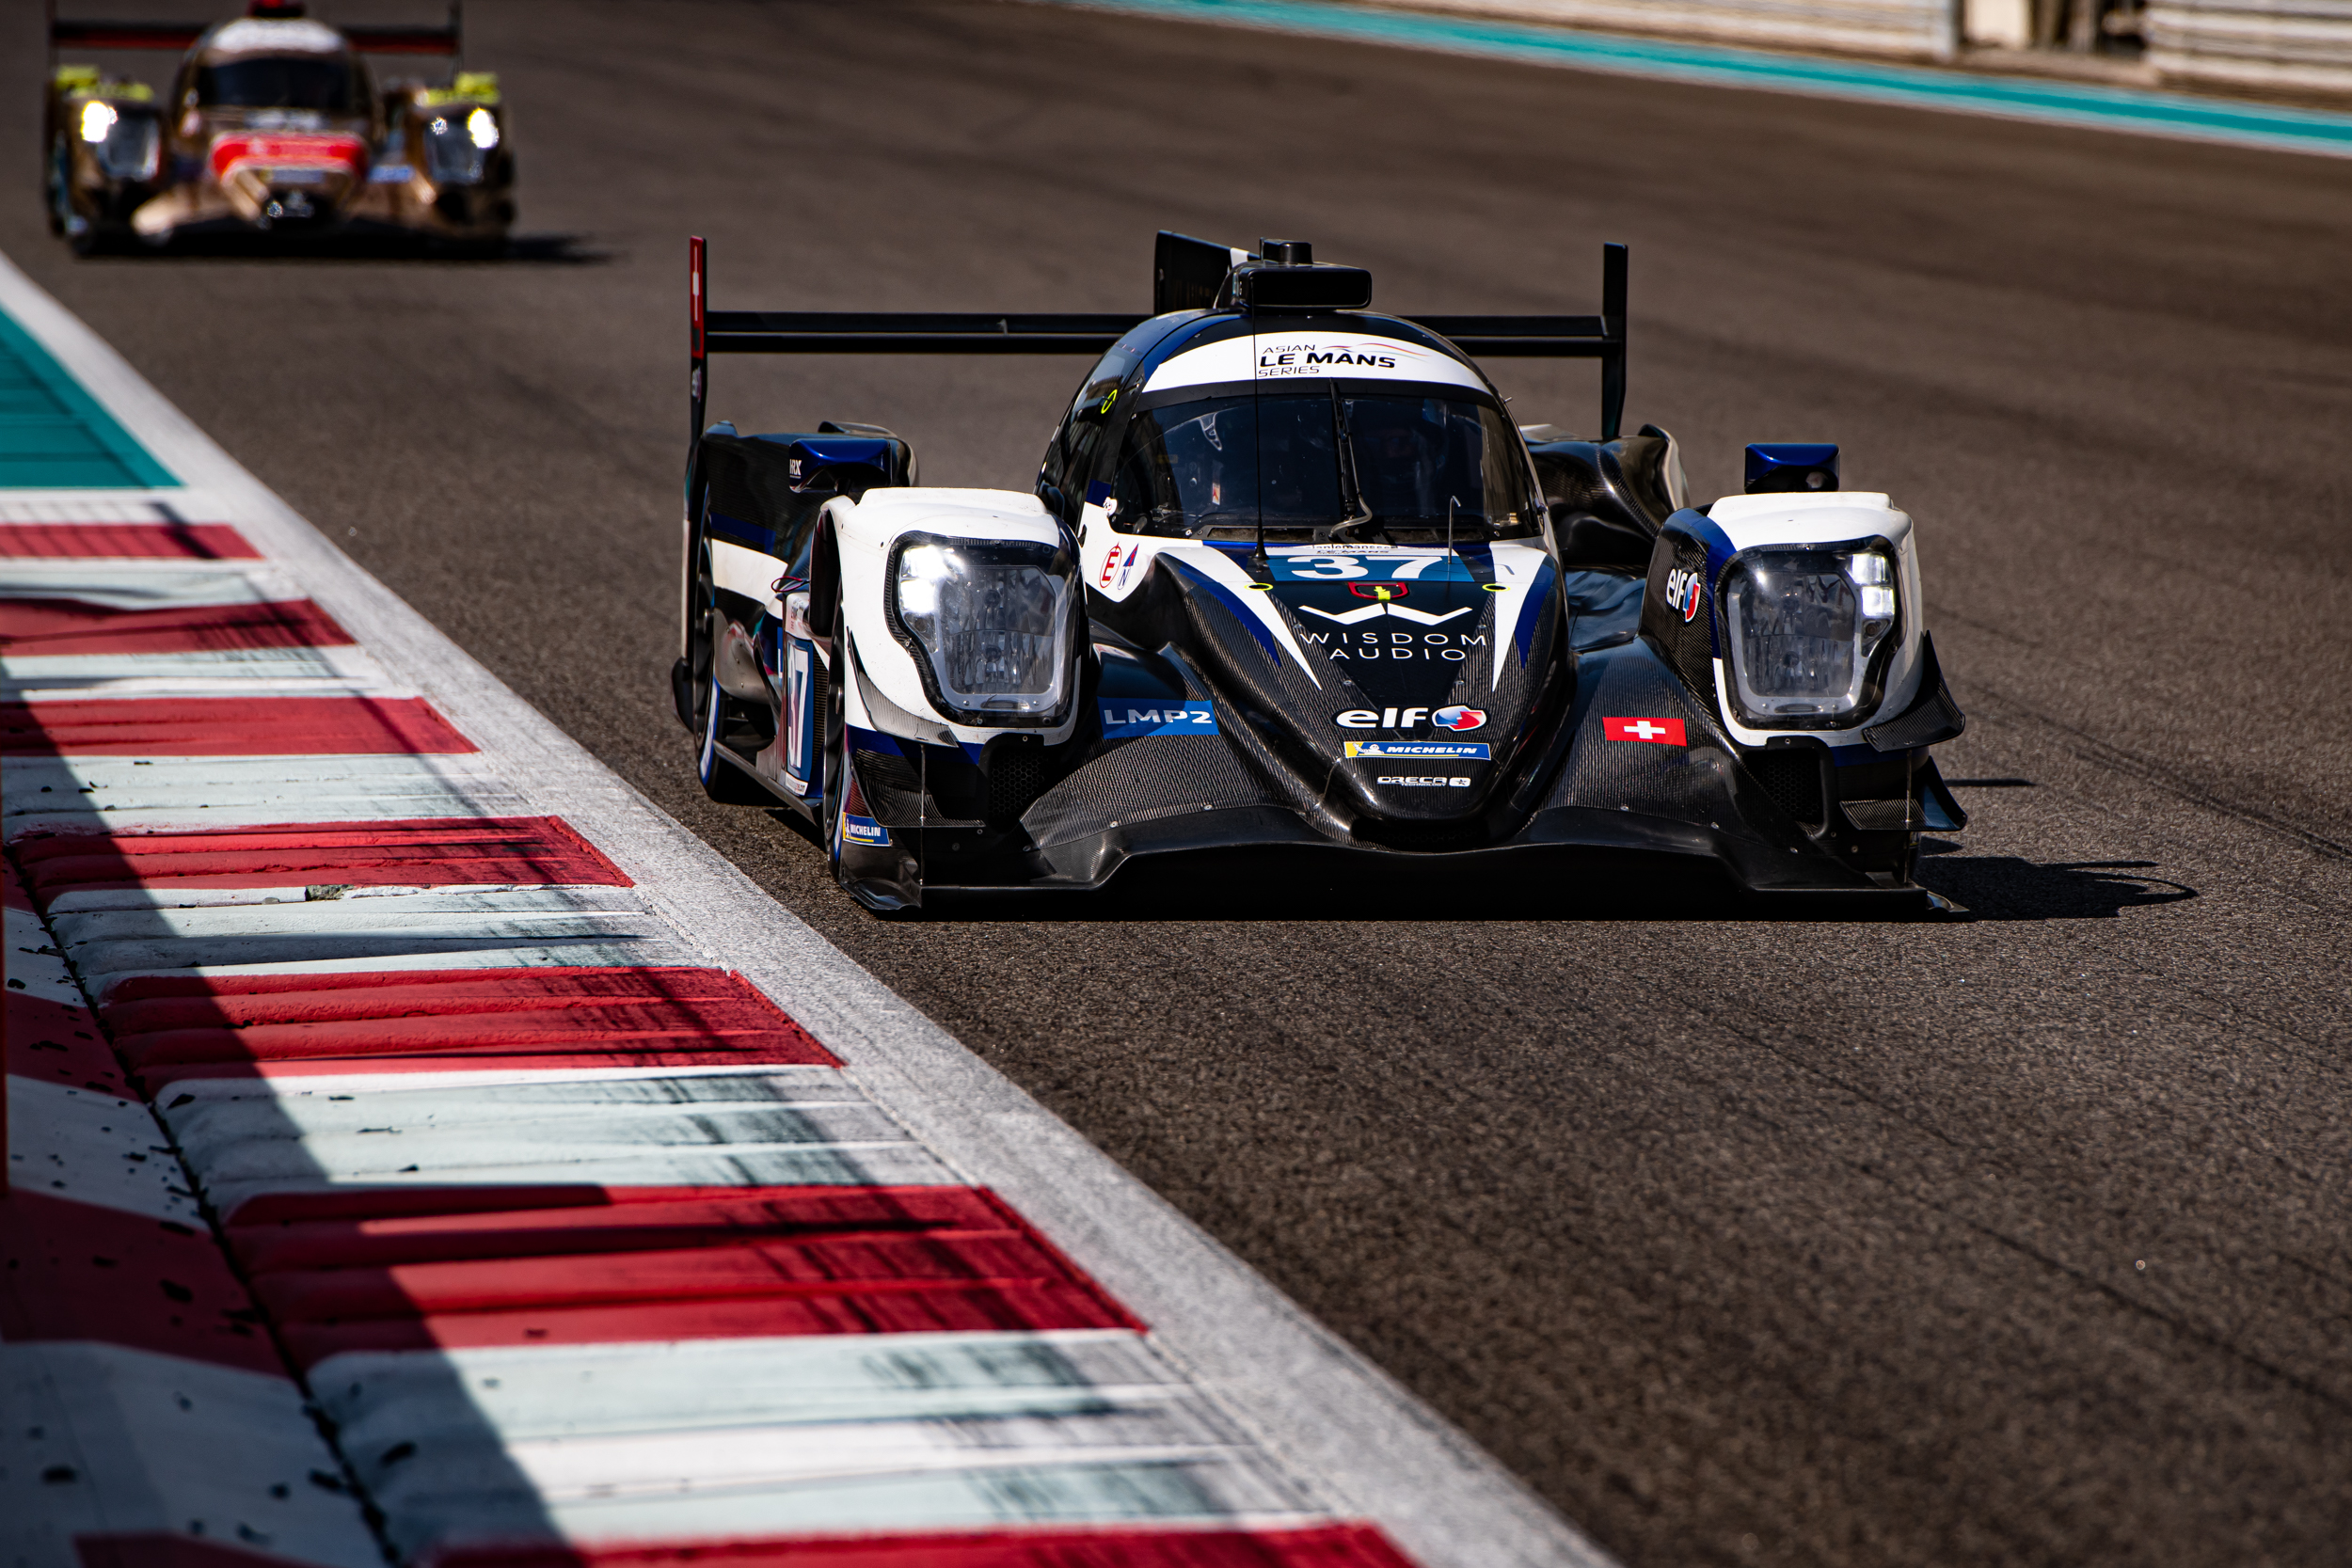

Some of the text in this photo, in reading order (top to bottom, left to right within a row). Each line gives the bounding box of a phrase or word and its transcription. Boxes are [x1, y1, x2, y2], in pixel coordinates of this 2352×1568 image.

[1263, 344, 1315, 355] ASIAN
[1260, 353, 1395, 369] LE MANS
[1258, 366, 1320, 377] SERIES
[1287, 556, 1442, 579] 37
[1666, 568, 1688, 610] elf
[1300, 632, 1486, 646] WISDOM
[1329, 648, 1466, 660] AUDIO
[788, 642, 809, 768] 37
[1104, 709, 1213, 724] LMP2
[1336, 707, 1429, 728] elf
[1386, 746, 1478, 754] MICHELIN
[1377, 776, 1447, 784] ORECA
[850, 823, 882, 836] MICHELIN
